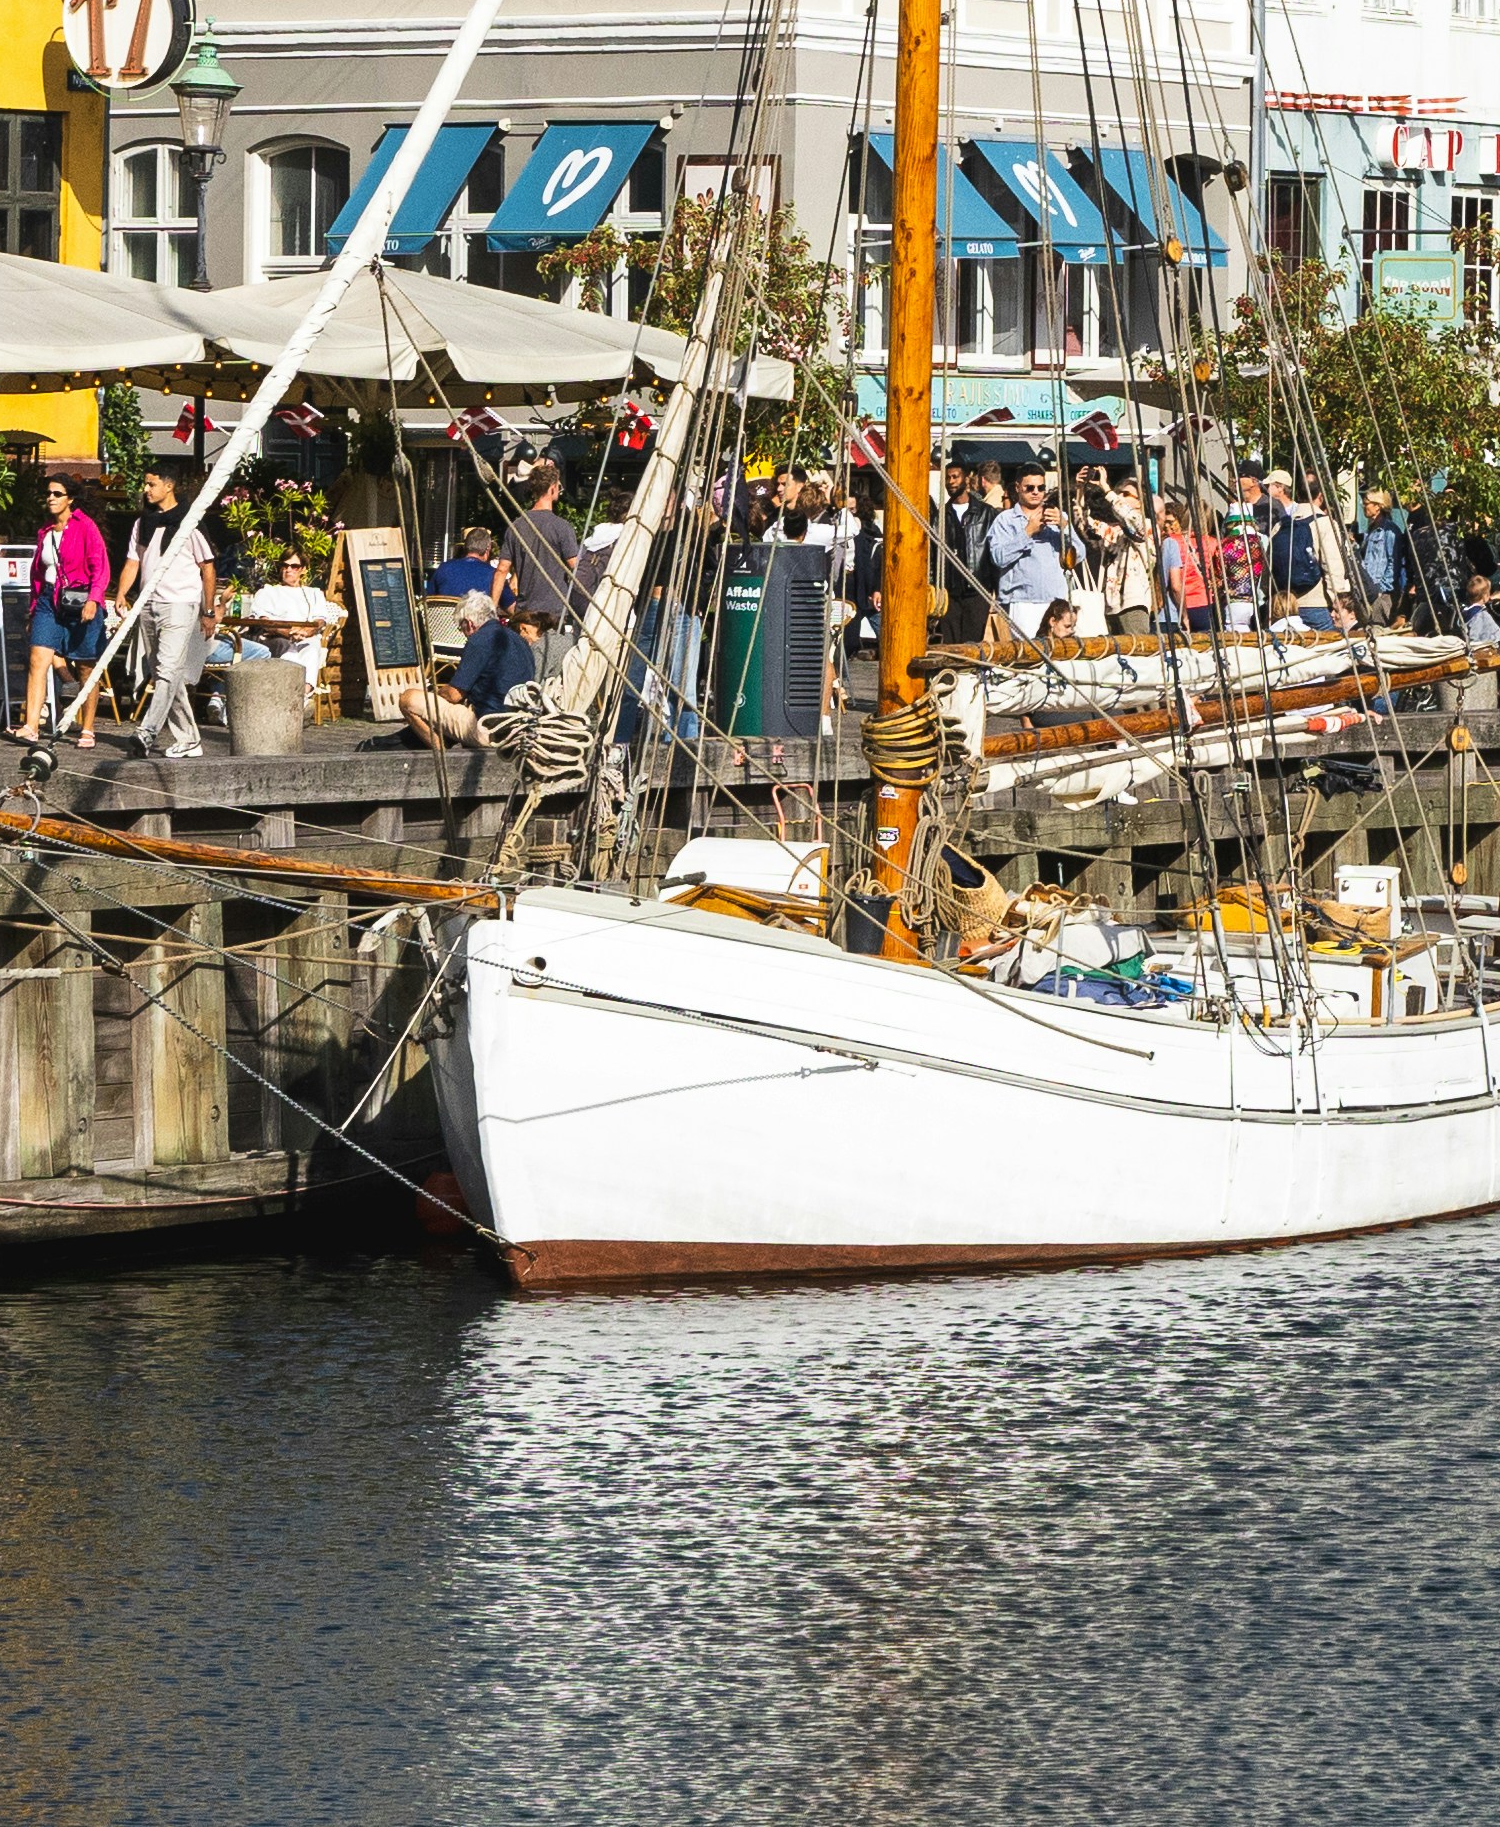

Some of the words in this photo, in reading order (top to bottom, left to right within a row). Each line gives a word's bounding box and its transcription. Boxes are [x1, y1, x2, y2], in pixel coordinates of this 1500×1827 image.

[1392, 124, 1464, 174] CAP
[966, 243, 993, 255] GELATO
[1027, 410, 1054, 421] SHAKES
[726, 586, 761, 597] Affald
[726, 601, 758, 612] Waste
